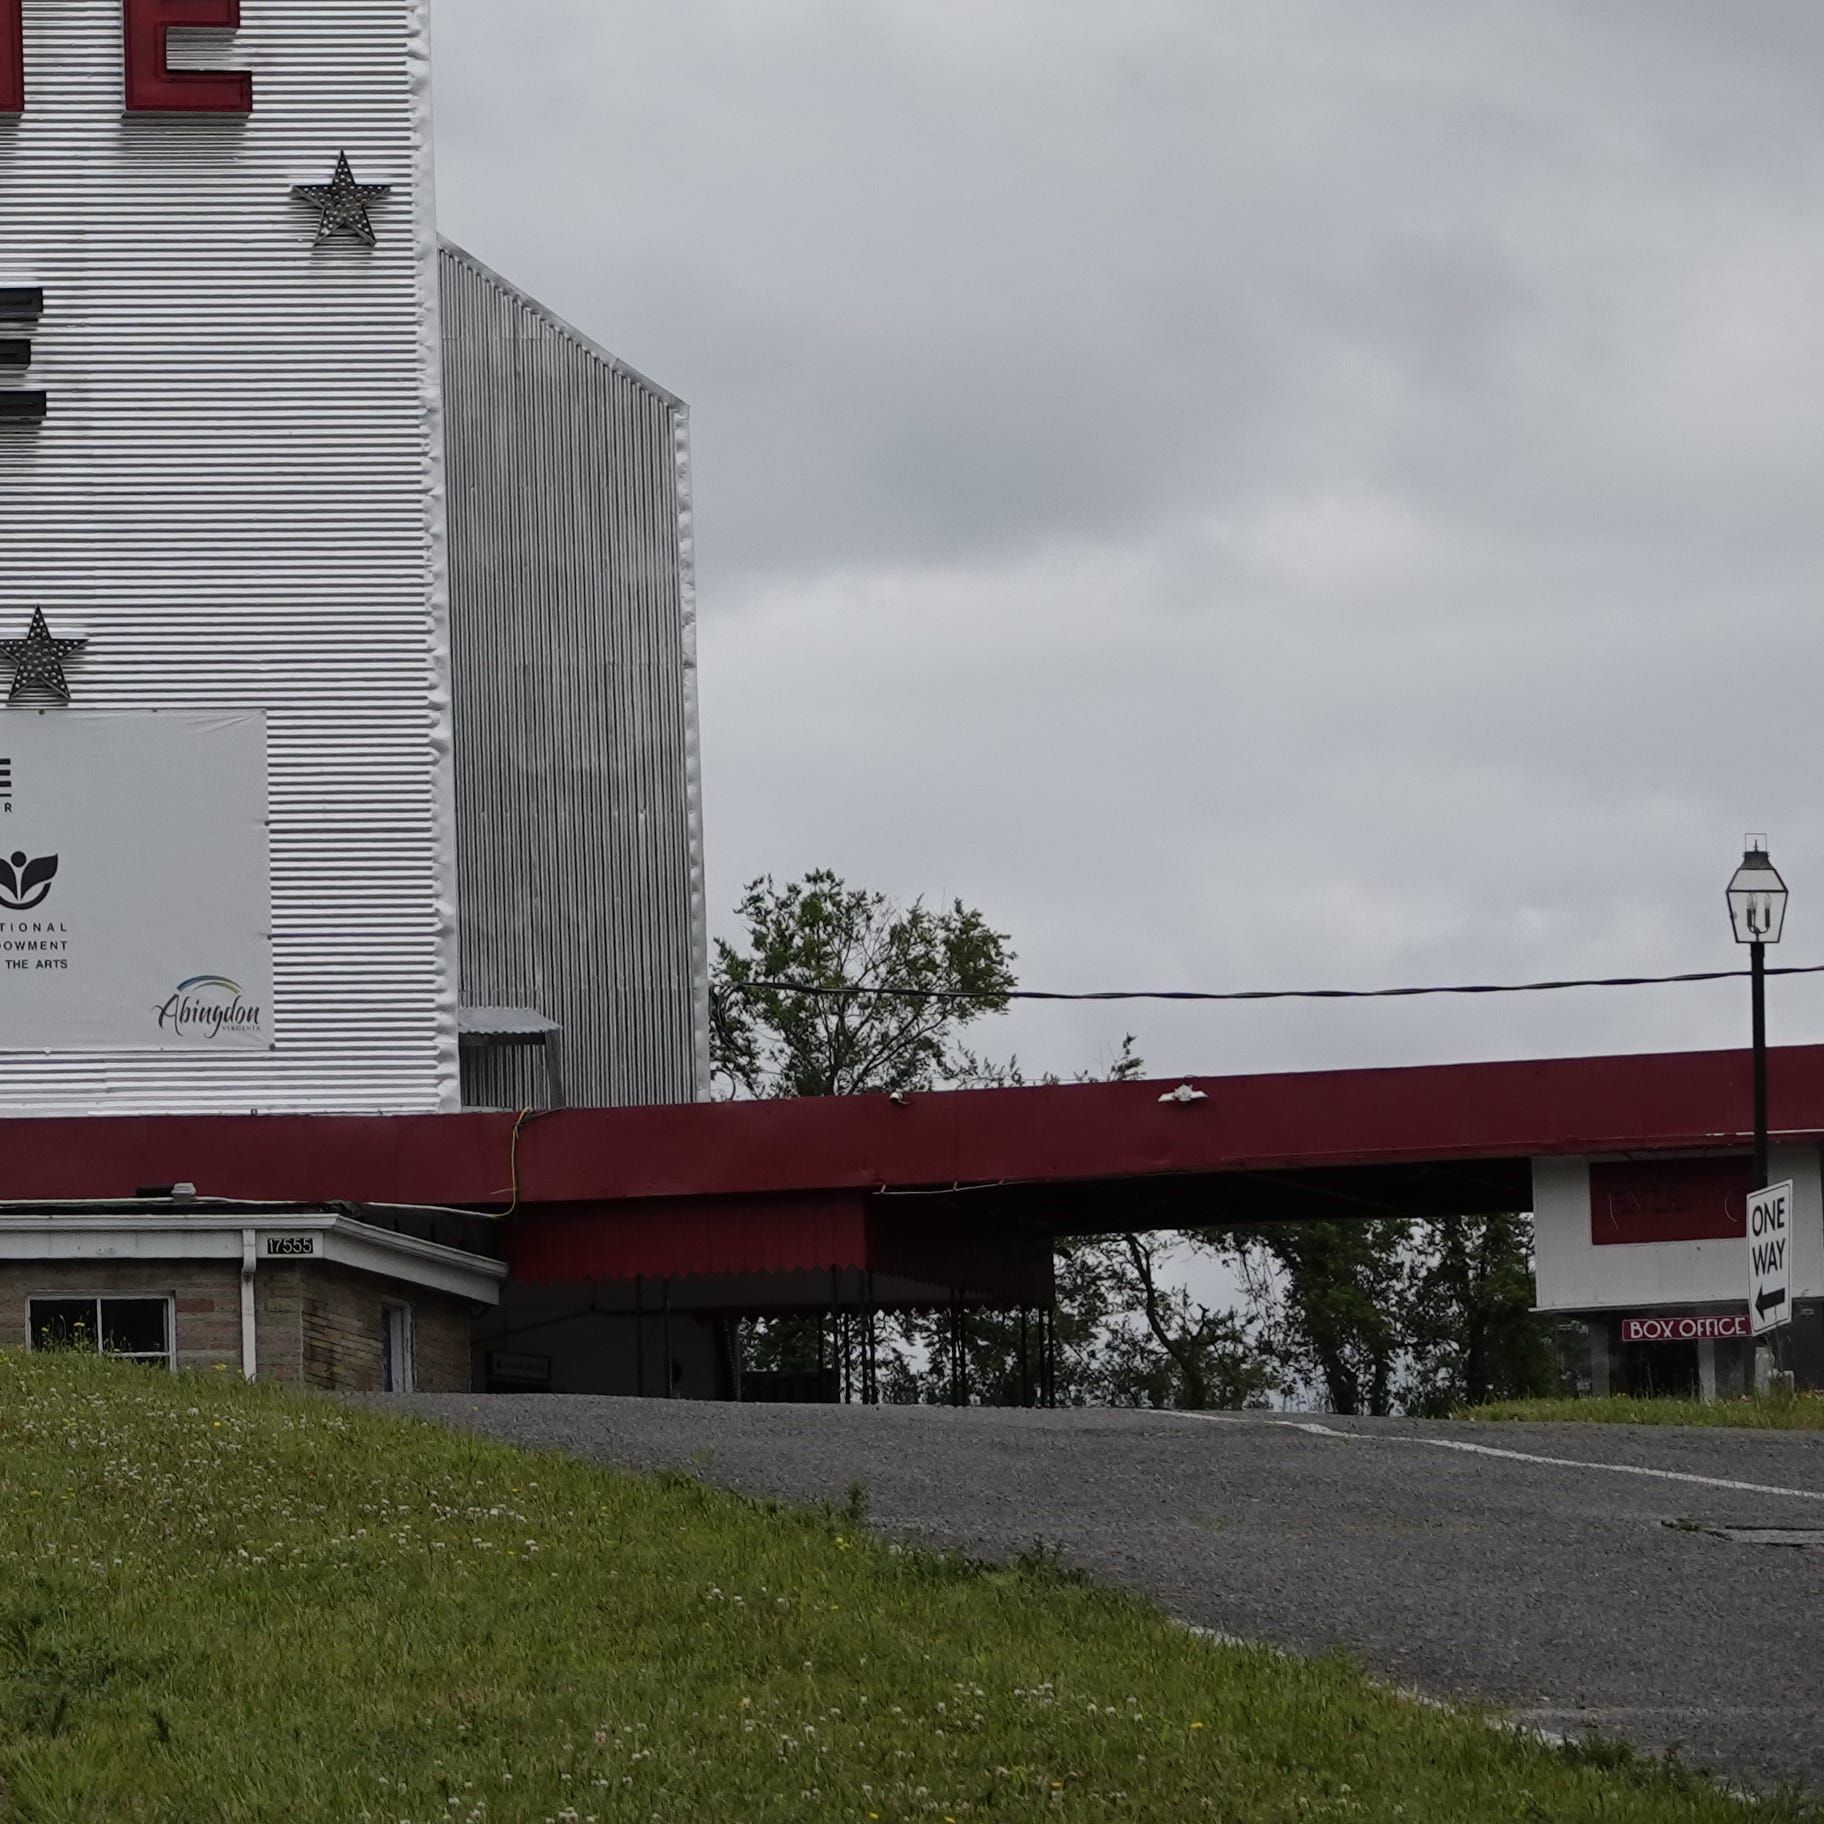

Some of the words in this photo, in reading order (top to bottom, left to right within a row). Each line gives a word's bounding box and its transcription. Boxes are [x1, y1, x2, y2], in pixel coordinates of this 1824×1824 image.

[4, 959, 30, 969] THE
[35, 958, 69, 969] ARTS
[151, 993, 261, 1039] Abingdon
[1752, 1196, 1785, 1237] ONE
[269, 1238, 312, 1253] 17555
[1752, 1237, 1786, 1277] WAY
[1630, 1319, 1674, 1338] BOX
[1679, 1317, 1747, 1337] OFFICE
